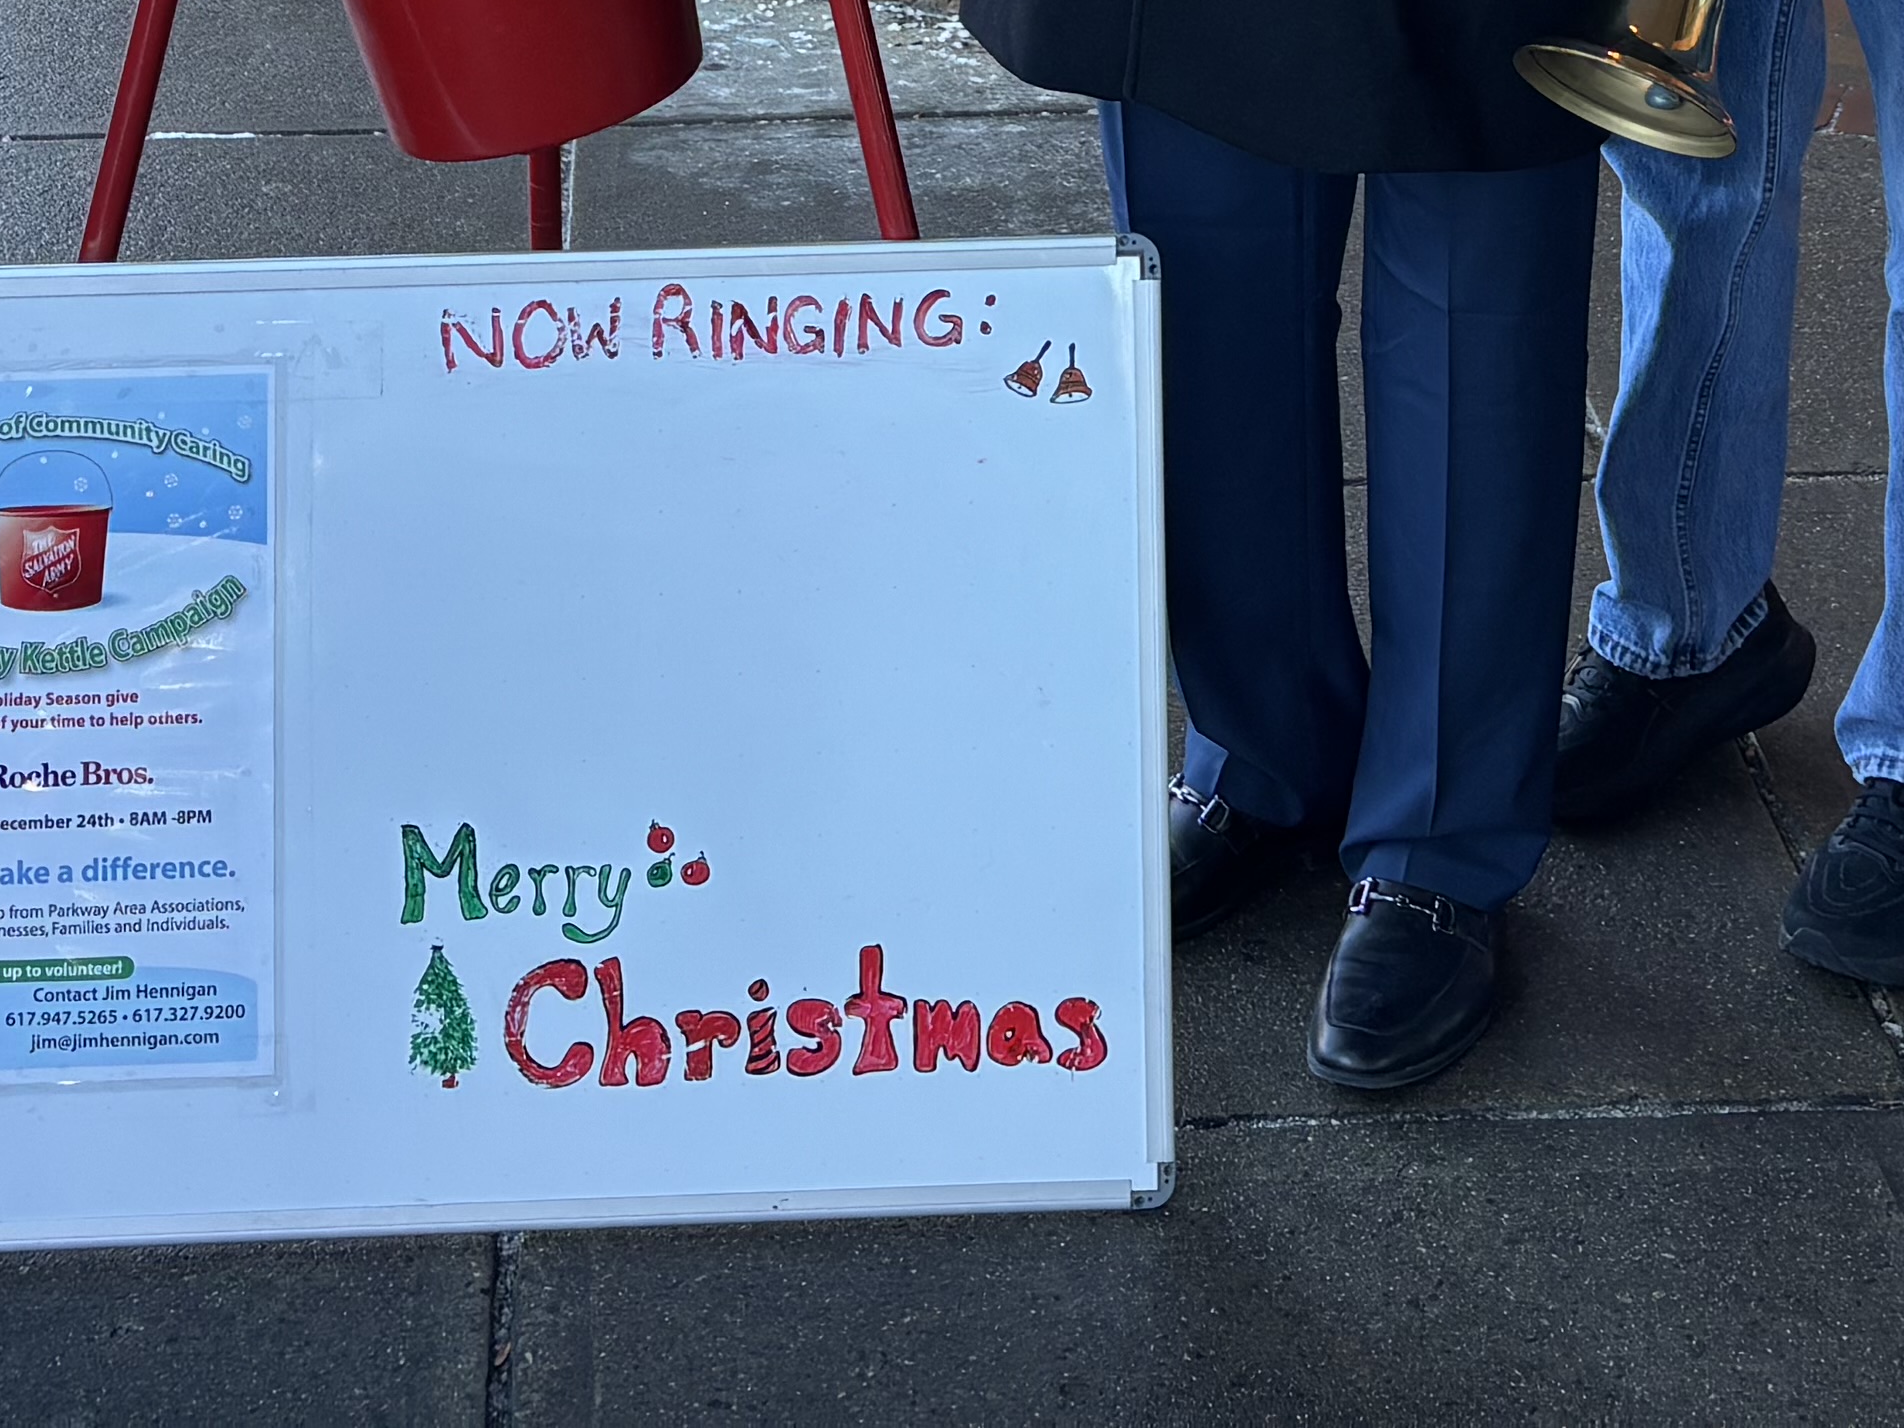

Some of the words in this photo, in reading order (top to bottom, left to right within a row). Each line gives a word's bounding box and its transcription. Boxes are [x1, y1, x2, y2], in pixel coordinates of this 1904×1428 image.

[440, 294, 623, 372] NOW
[651, 283, 998, 361] RINGING:
[26, 413, 172, 453] Community
[170, 429, 252, 483] Caring
[17, 636, 108, 675] Kettle
[107, 574, 248, 661] Campaign
[45, 692, 102, 706] Season
[105, 690, 139, 708] give
[10, 716, 47, 733] your
[50, 714, 86, 729] time
[88, 714, 105, 727] to
[109, 712, 145, 730] help
[148, 711, 203, 726] others.
[80, 761, 155, 786] Bros.
[76, 813, 115, 828] 24th
[128, 812, 167, 826] 8AM
[171, 810, 212, 825] -8PM
[57, 866, 74, 883] a
[80, 856, 236, 882] difference.
[399, 822, 632, 943] Merry
[9, 905, 44, 919] from
[48, 903, 109, 919] Parkway
[113, 901, 146, 915] Area
[151, 897, 245, 914] Associations,
[52, 920, 111, 936] Families
[114, 919, 142, 933] and
[146, 915, 230, 932] Individuals.
[2, 967, 22, 980] up
[26, 965, 42, 976] to
[46, 960, 122, 976] volunteer!
[33, 987, 98, 1002] Contact
[102, 986, 131, 1001] Jim
[137, 982, 217, 1001] Hennigan
[6, 1010, 117, 1027] 617.947.5265
[132, 1004, 245, 1023] 617.327.9200
[504, 943, 1110, 1090] Christmas
